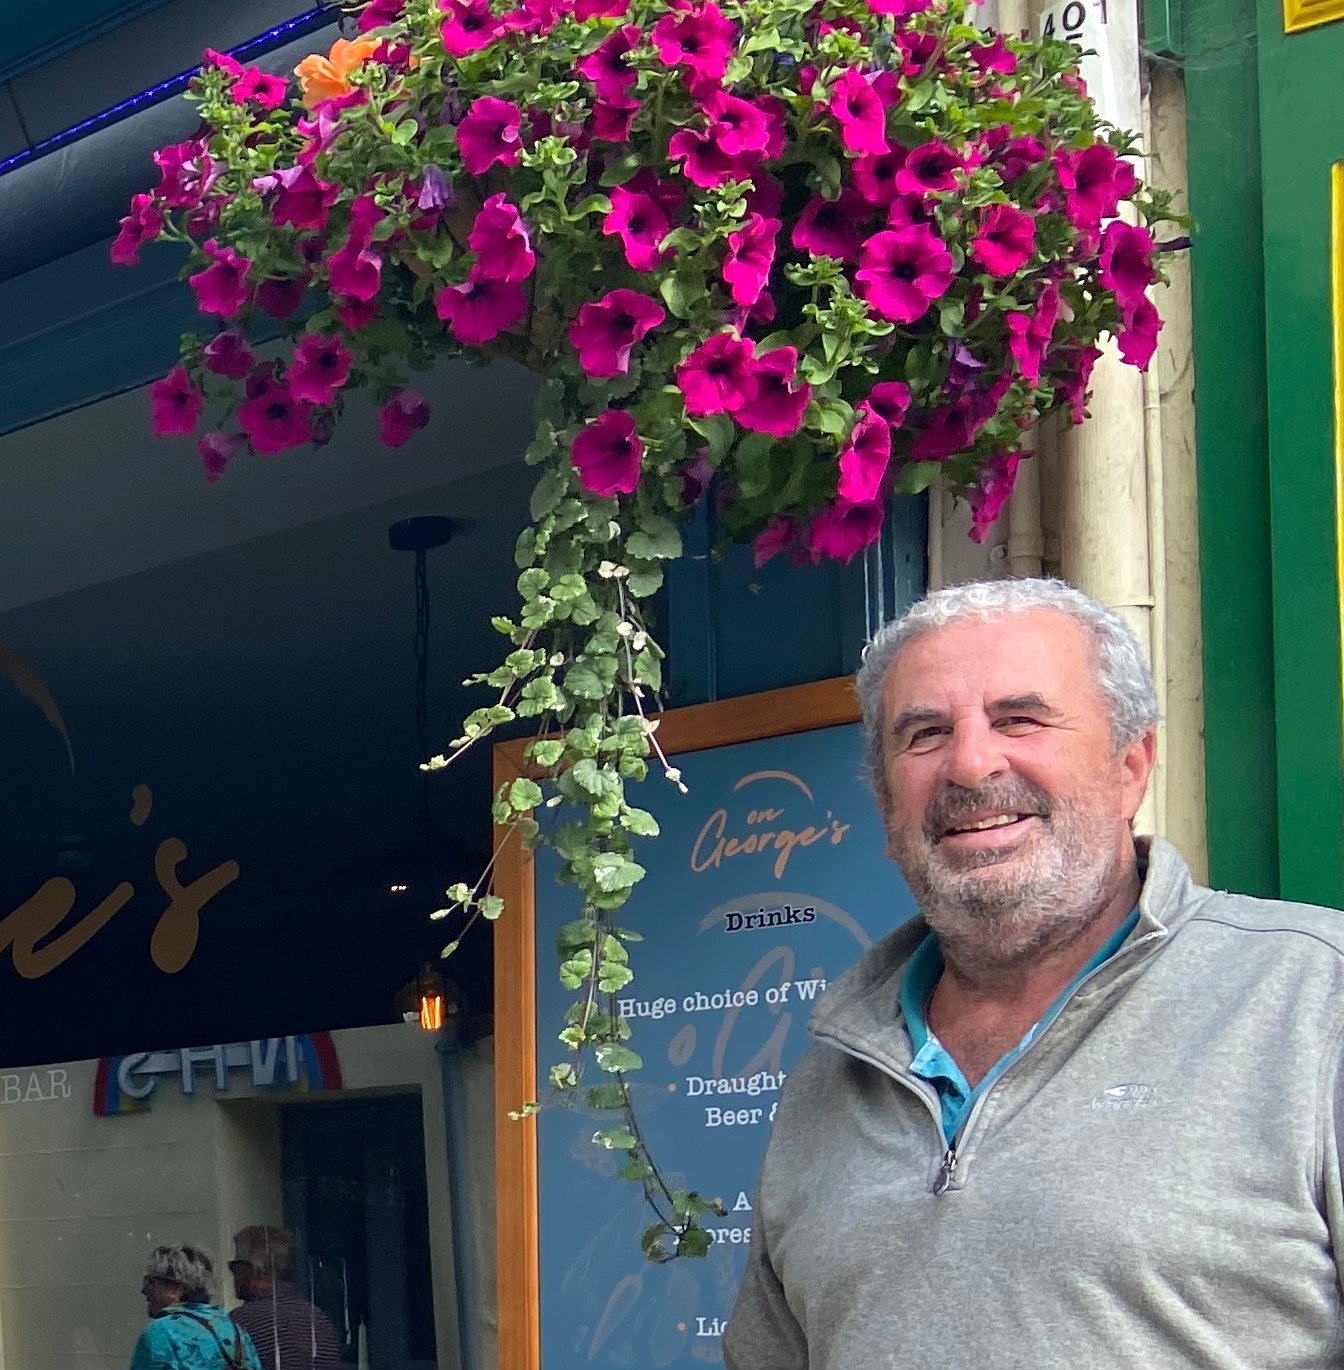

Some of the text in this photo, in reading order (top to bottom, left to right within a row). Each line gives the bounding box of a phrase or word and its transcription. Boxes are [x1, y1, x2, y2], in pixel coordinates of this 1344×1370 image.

[747, 806, 784, 825] on
[690, 808, 851, 879] George's
[724, 905, 816, 933] Drinks
[617, 995, 677, 1020] Huge
[683, 987, 759, 1012] choice
[765, 982, 792, 1003] of
[0, 1069, 71, 1105] BAR
[705, 1104, 762, 1127] Beer
